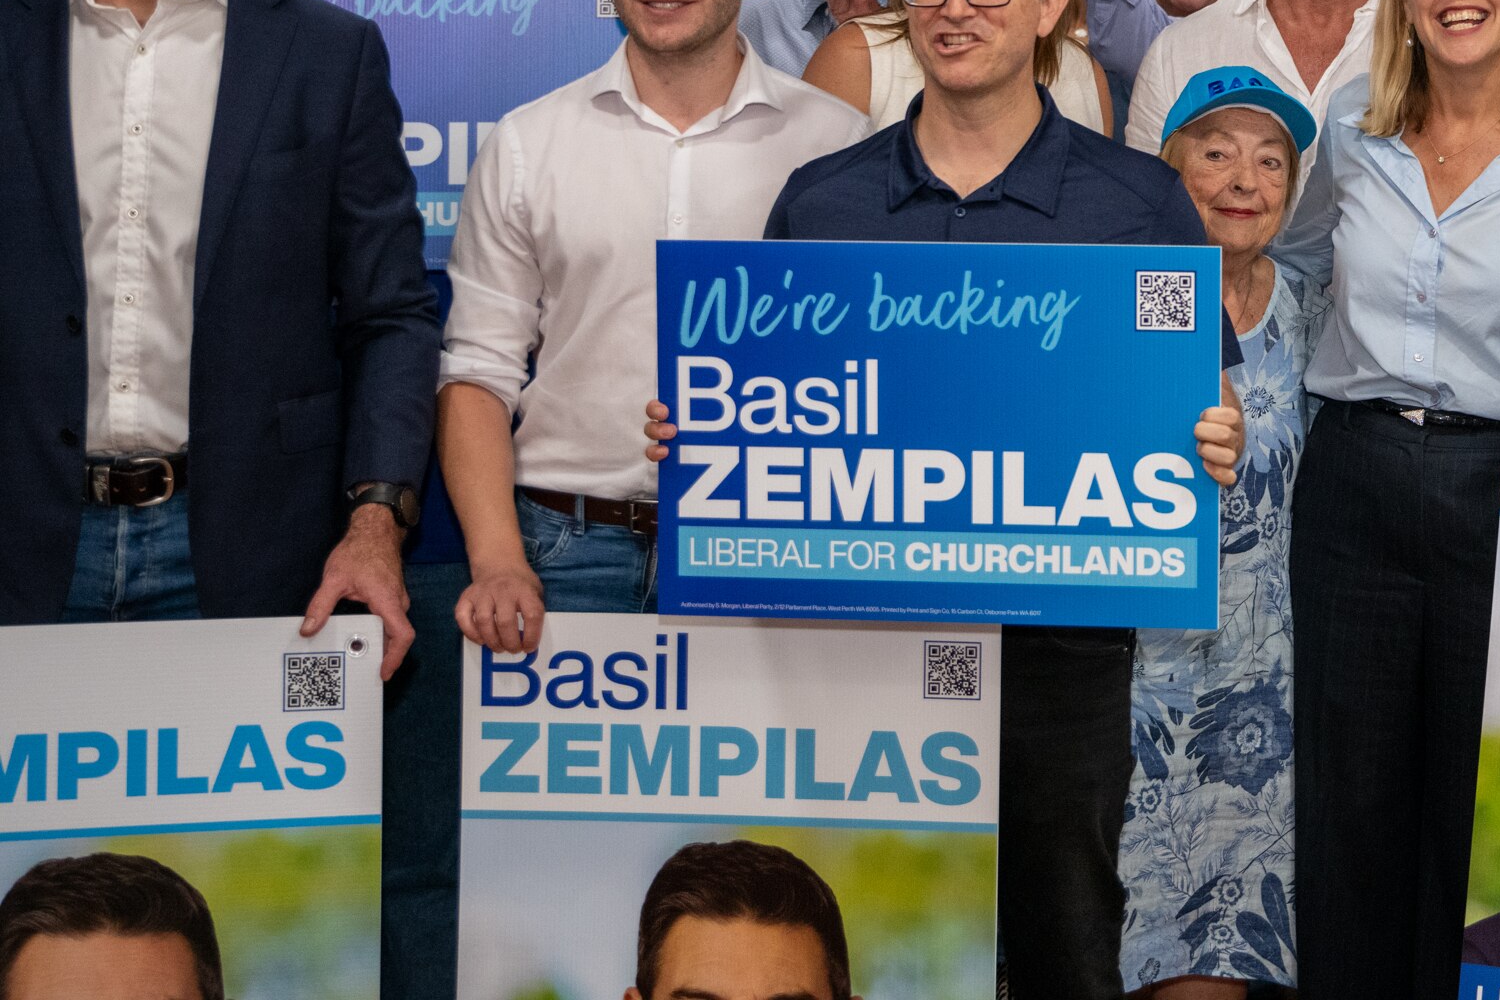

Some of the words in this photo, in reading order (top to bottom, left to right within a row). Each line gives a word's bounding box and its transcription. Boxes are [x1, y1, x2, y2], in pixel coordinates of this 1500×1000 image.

[680, 266, 850, 347] We're
[868, 270, 1081, 351] backing
[676, 355, 879, 435] Basil
[677, 446, 1197, 530] ZEMPILAS
[690, 537, 821, 569] LIBERAL
[830, 541, 896, 571] FOR
[905, 543, 1186, 577] CHURCHLANDS
[481, 633, 688, 710] Basil
[0, 720, 346, 803] MPILAS
[480, 721, 981, 806] ZEMPILAS
